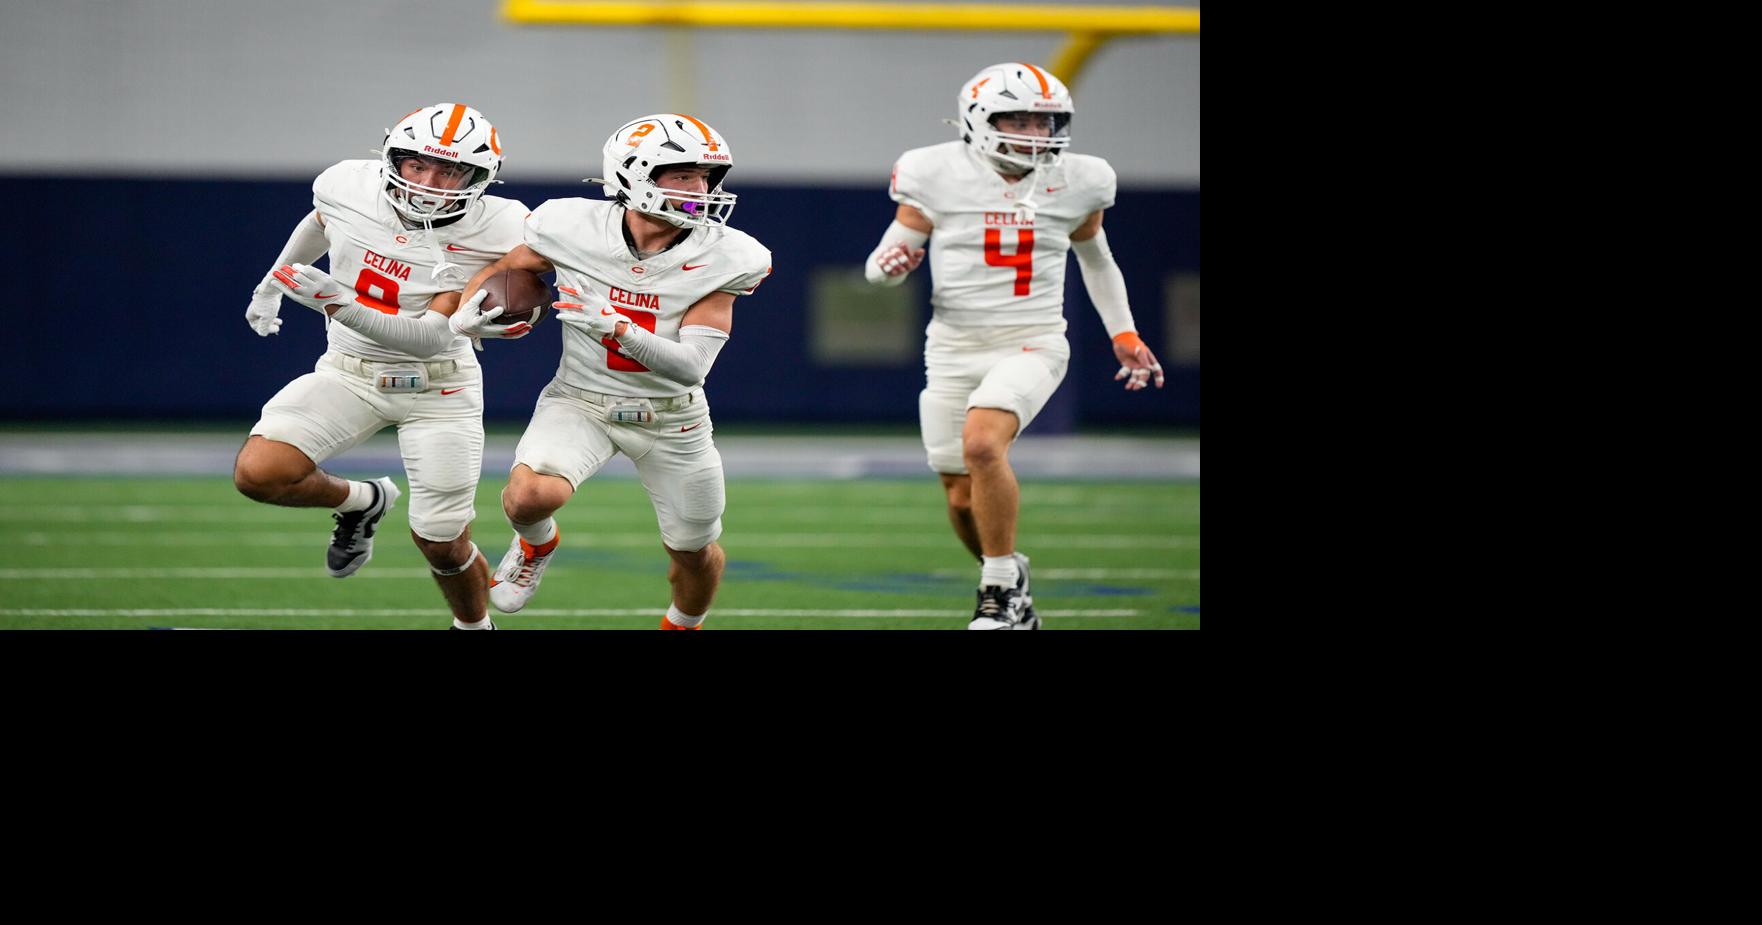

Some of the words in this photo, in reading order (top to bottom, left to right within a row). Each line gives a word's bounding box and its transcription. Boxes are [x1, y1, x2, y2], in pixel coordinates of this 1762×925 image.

[626, 123, 656, 148] 2
[424, 144, 459, 159] Riddell
[703, 153, 730, 161] Riddell
[984, 211, 1034, 226] CELI
[363, 249, 411, 281] CELINA
[984, 228, 1034, 296] 4
[609, 286, 660, 311] CELINA
